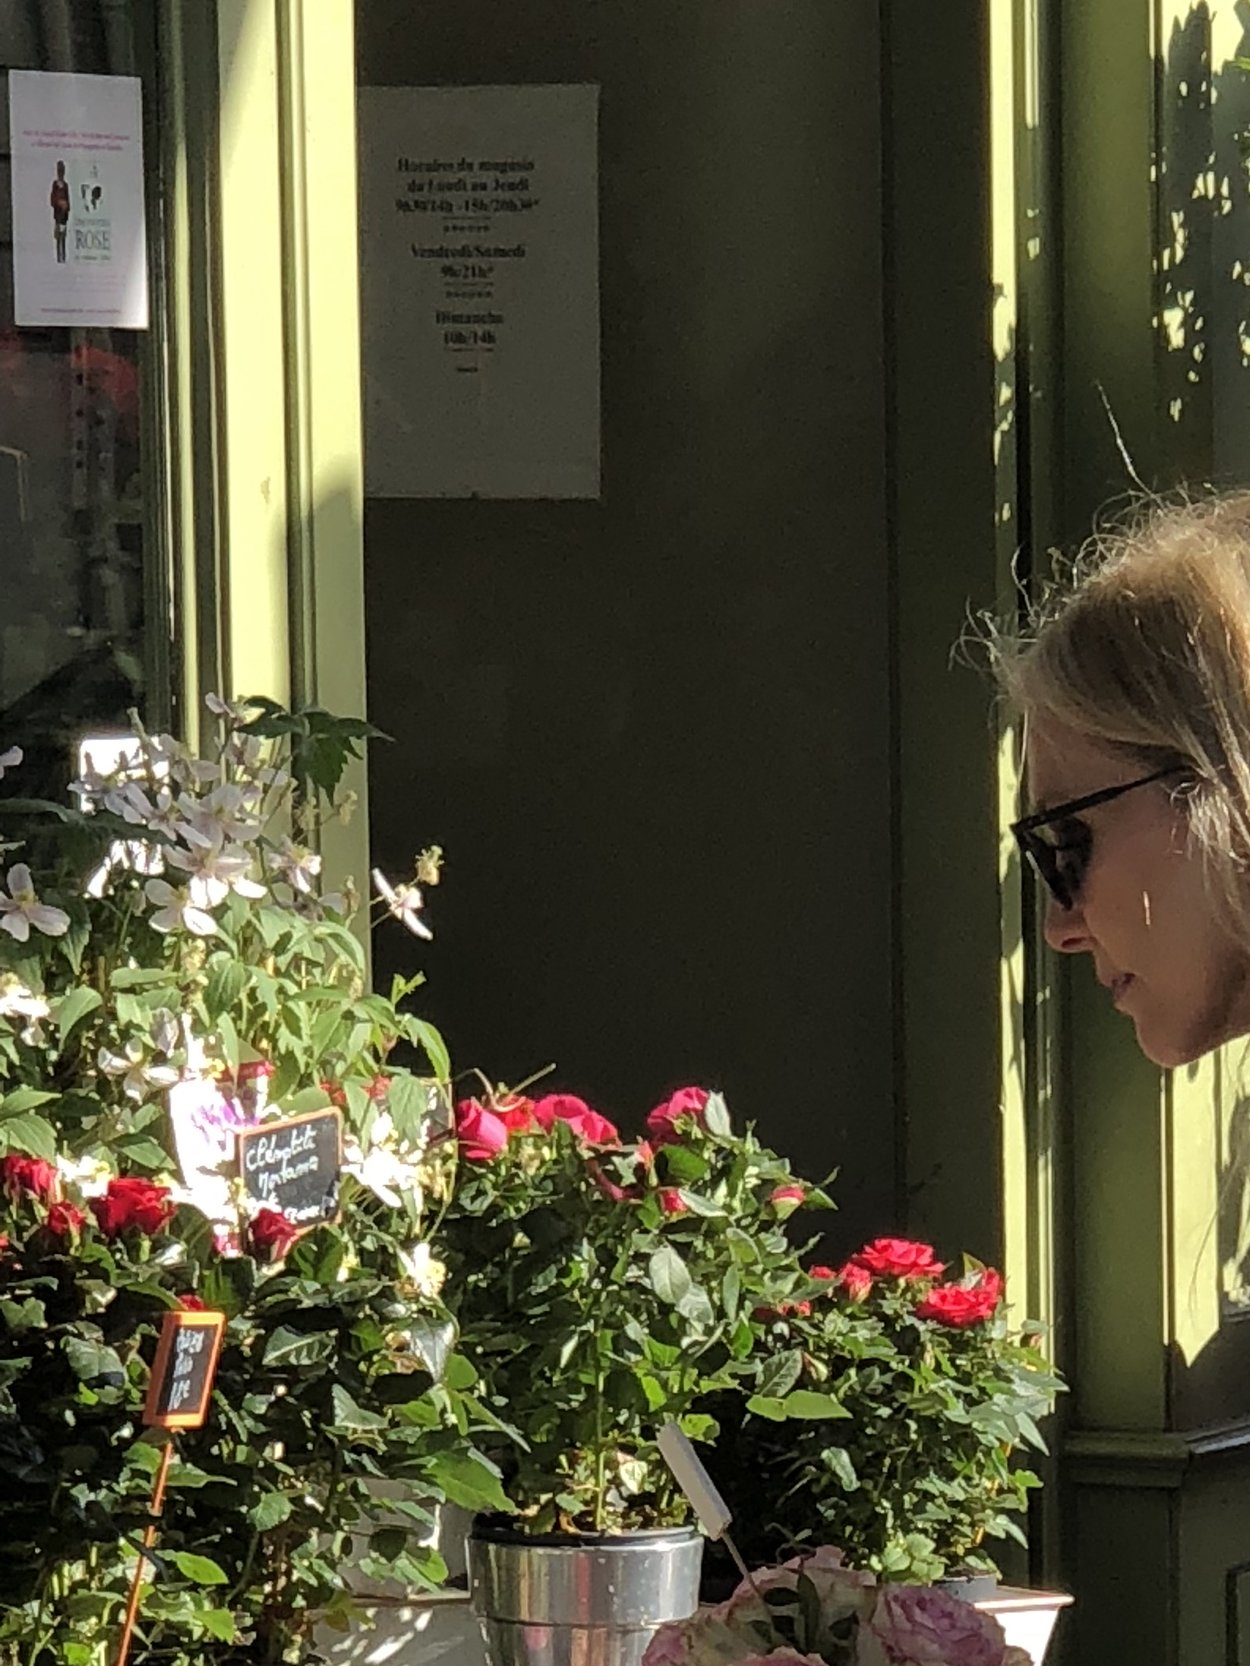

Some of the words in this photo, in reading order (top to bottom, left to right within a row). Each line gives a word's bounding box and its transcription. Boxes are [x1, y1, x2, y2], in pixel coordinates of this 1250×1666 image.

[457, 157, 474, 172] du
[407, 178, 425, 193] du
[471, 181, 488, 193] au
[493, 178, 529, 192] Jeudi
[75, 229, 111, 251] ROSE
